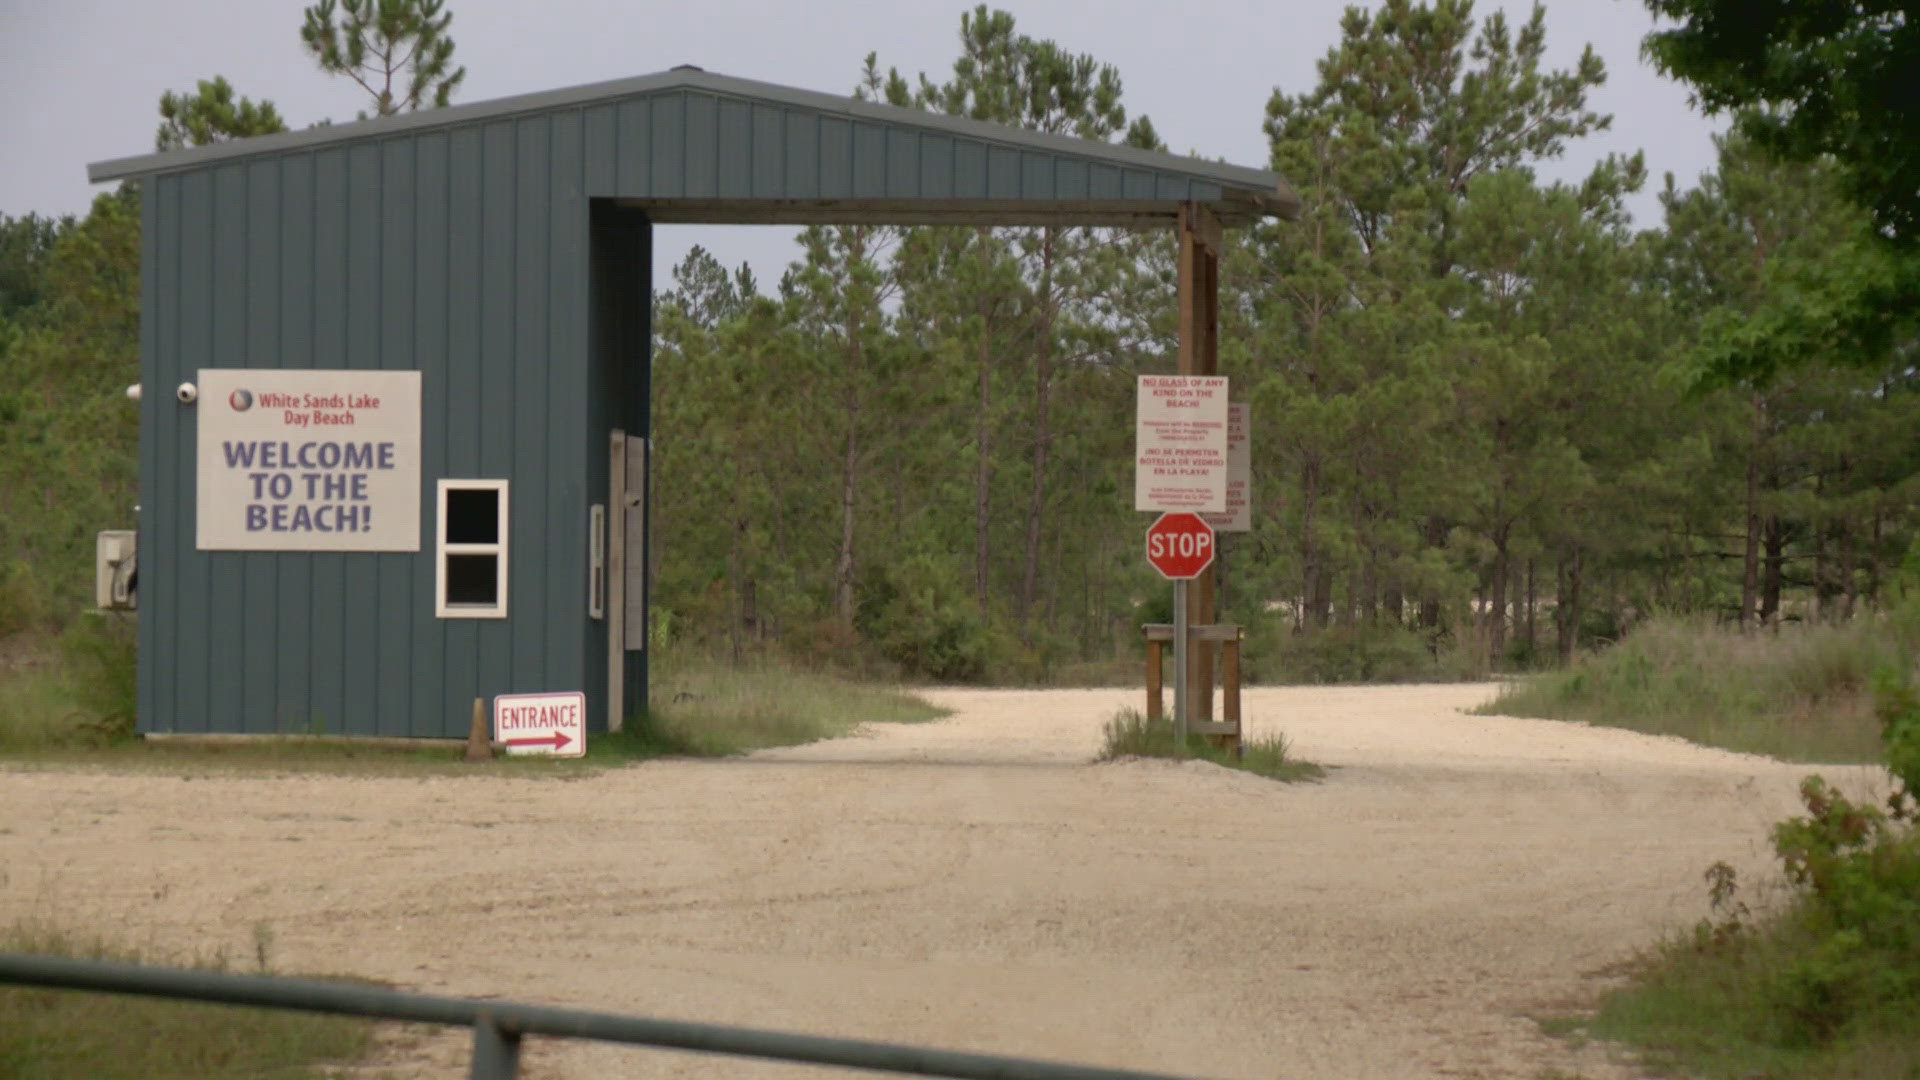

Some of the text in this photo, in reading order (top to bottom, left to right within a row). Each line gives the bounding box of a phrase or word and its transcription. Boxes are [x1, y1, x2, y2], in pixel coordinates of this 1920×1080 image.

[1142, 378, 1224, 387] NO GLASS OF ANY
[259, 392, 380, 409] White Sands Lake
[1153, 389, 1213, 398] KIND ON THE
[1166, 399, 1200, 408] BEACH!
[284, 410, 355, 428] Day Beach
[222, 441, 395, 470] WELCOME
[1163, 448, 1173, 456] SE
[1175, 448, 1219, 456] PERMITEN
[1140, 458, 1177, 466] BOTELLA
[1179, 458, 1189, 466] DE
[249, 473, 368, 501] TO THE
[245, 504, 372, 532] BEACH!
[1151, 533, 1210, 558] STOP
[502, 705, 577, 729] ENTRANCE
